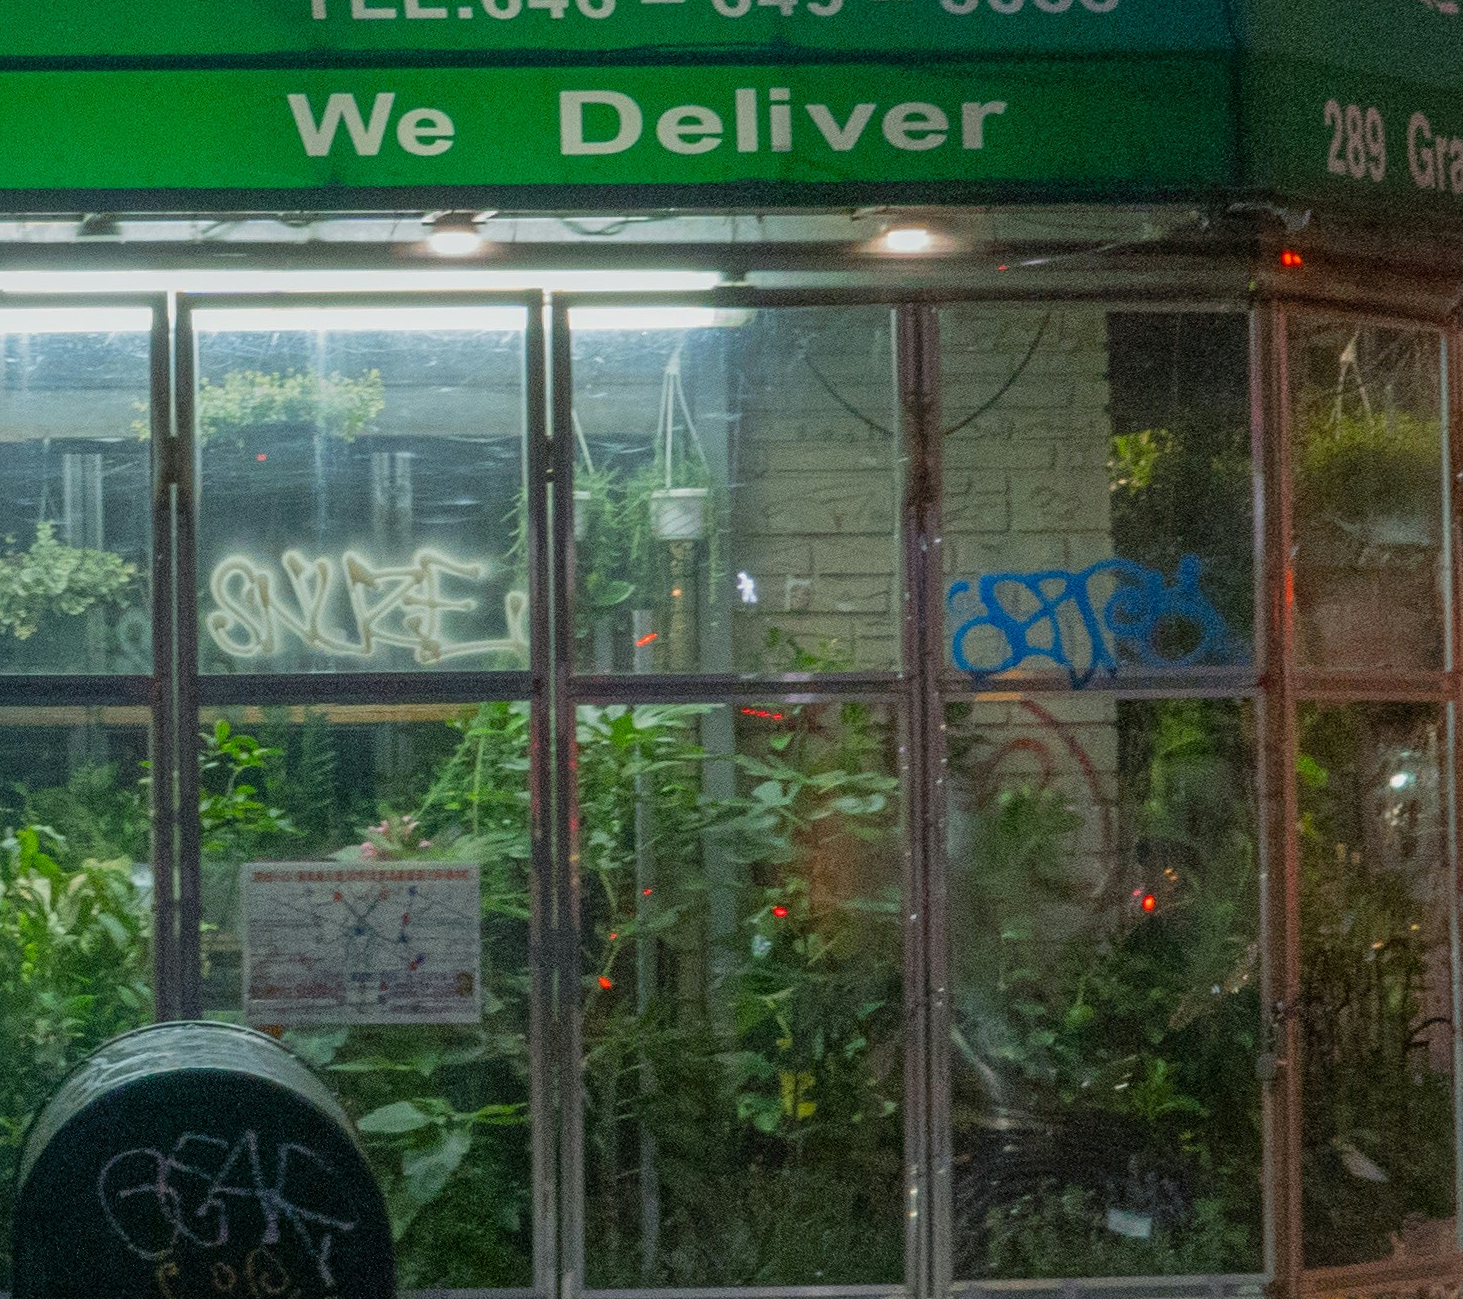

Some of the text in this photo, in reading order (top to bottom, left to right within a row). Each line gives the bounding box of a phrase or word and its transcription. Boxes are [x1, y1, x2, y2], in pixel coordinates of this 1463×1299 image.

[287, 87, 1006, 158] We Deliver
[1323, 98, 1388, 183] 289
